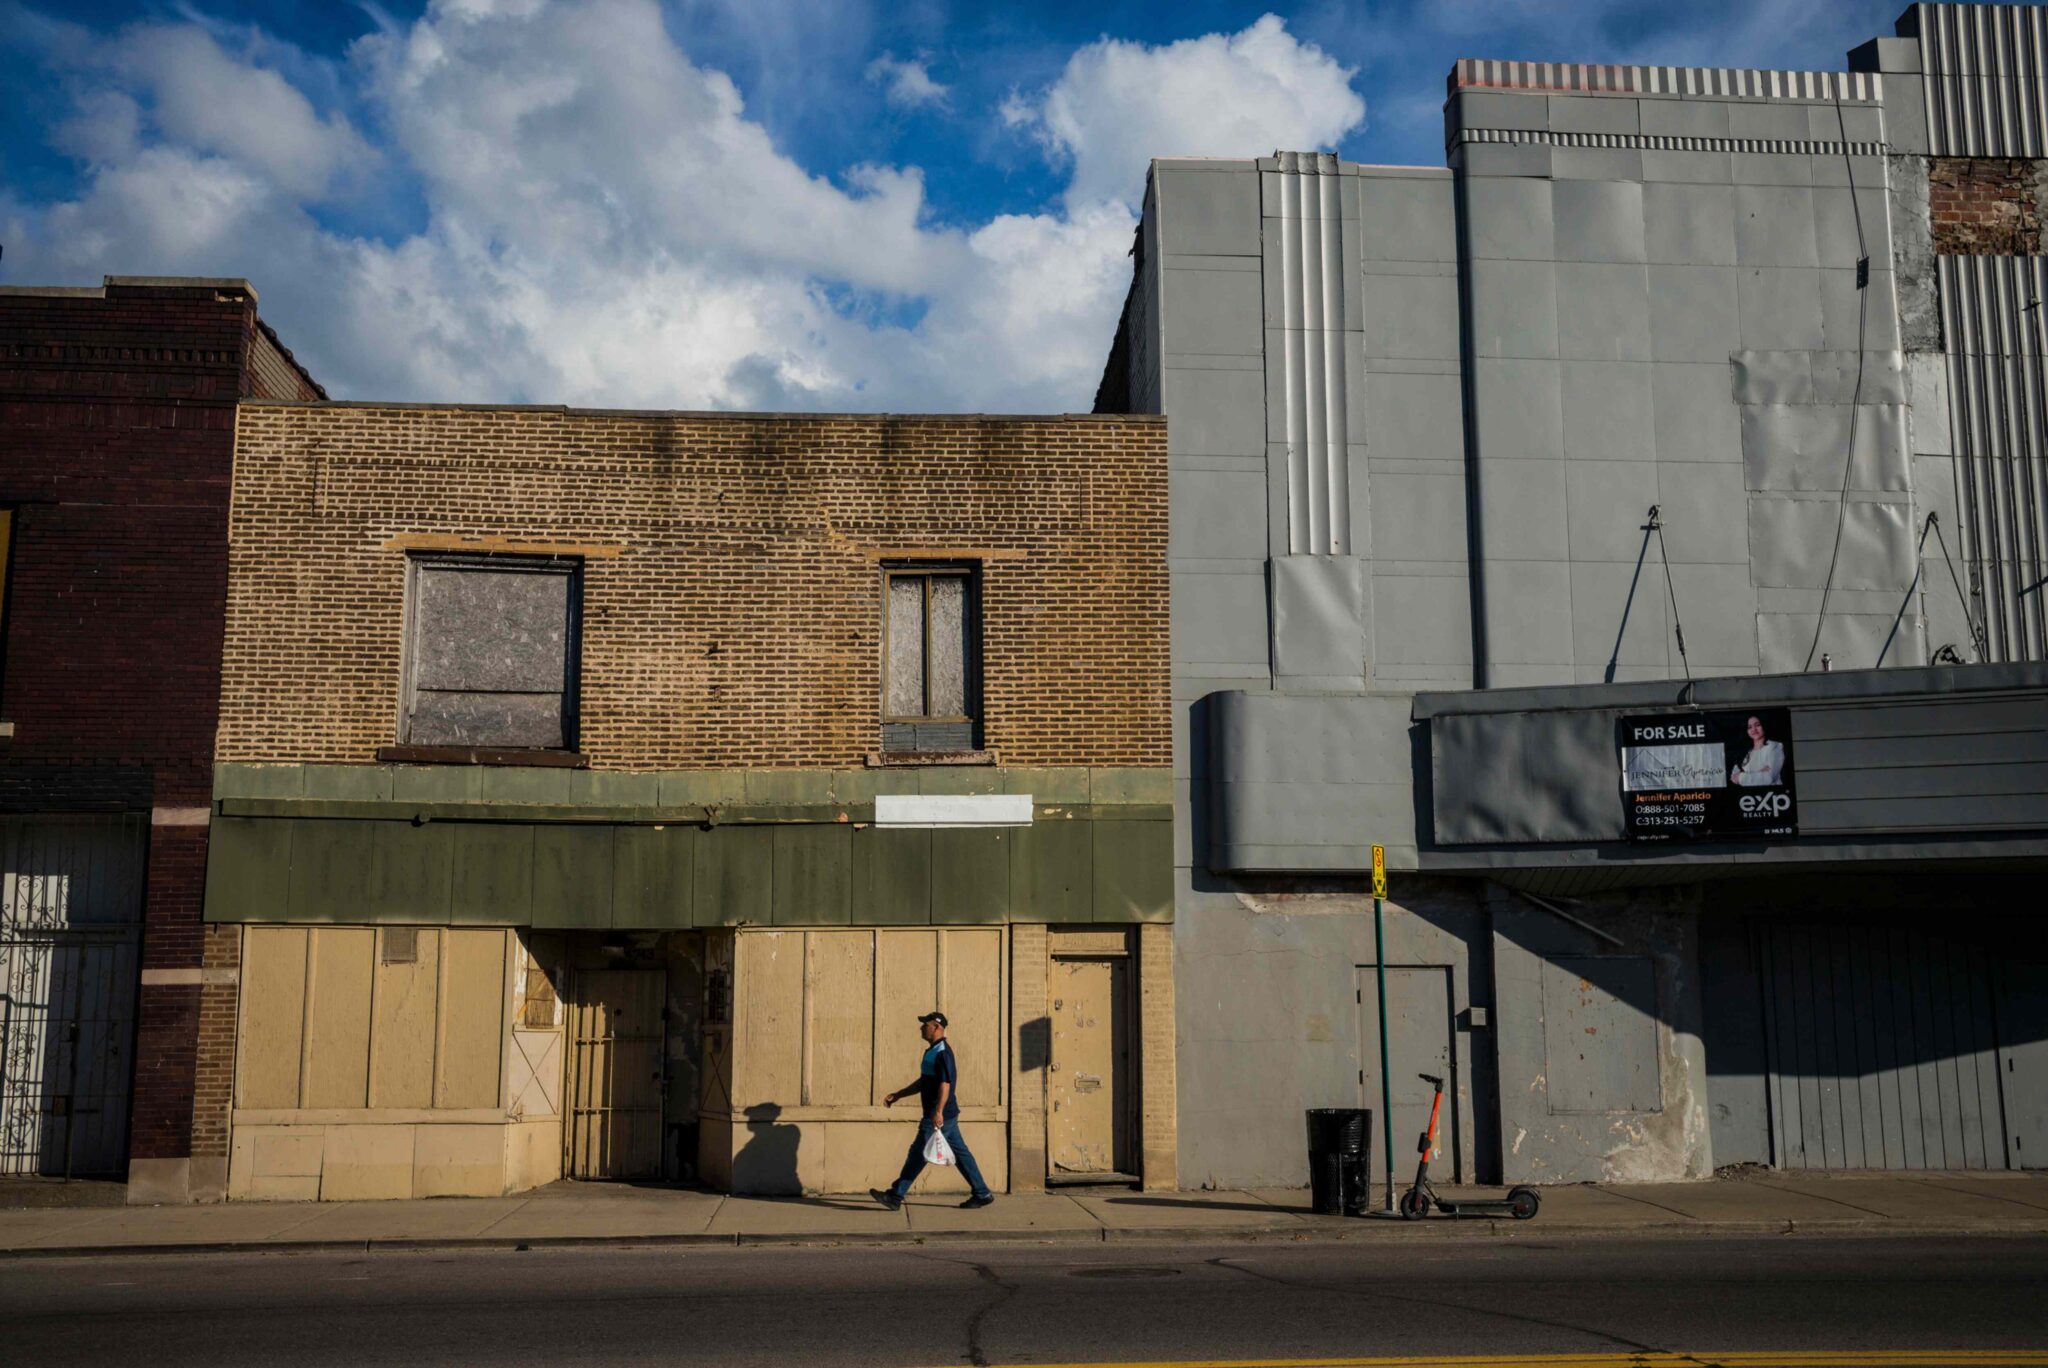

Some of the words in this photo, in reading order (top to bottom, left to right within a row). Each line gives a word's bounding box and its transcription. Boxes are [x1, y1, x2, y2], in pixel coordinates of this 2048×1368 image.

[1634, 727, 1665, 740] FOR
[1667, 724, 1706, 739] SALE
[1632, 770, 1681, 780] JENNIFER
[1635, 792, 1672, 802] Jennifer
[1673, 791, 1712, 802] Aparicio
